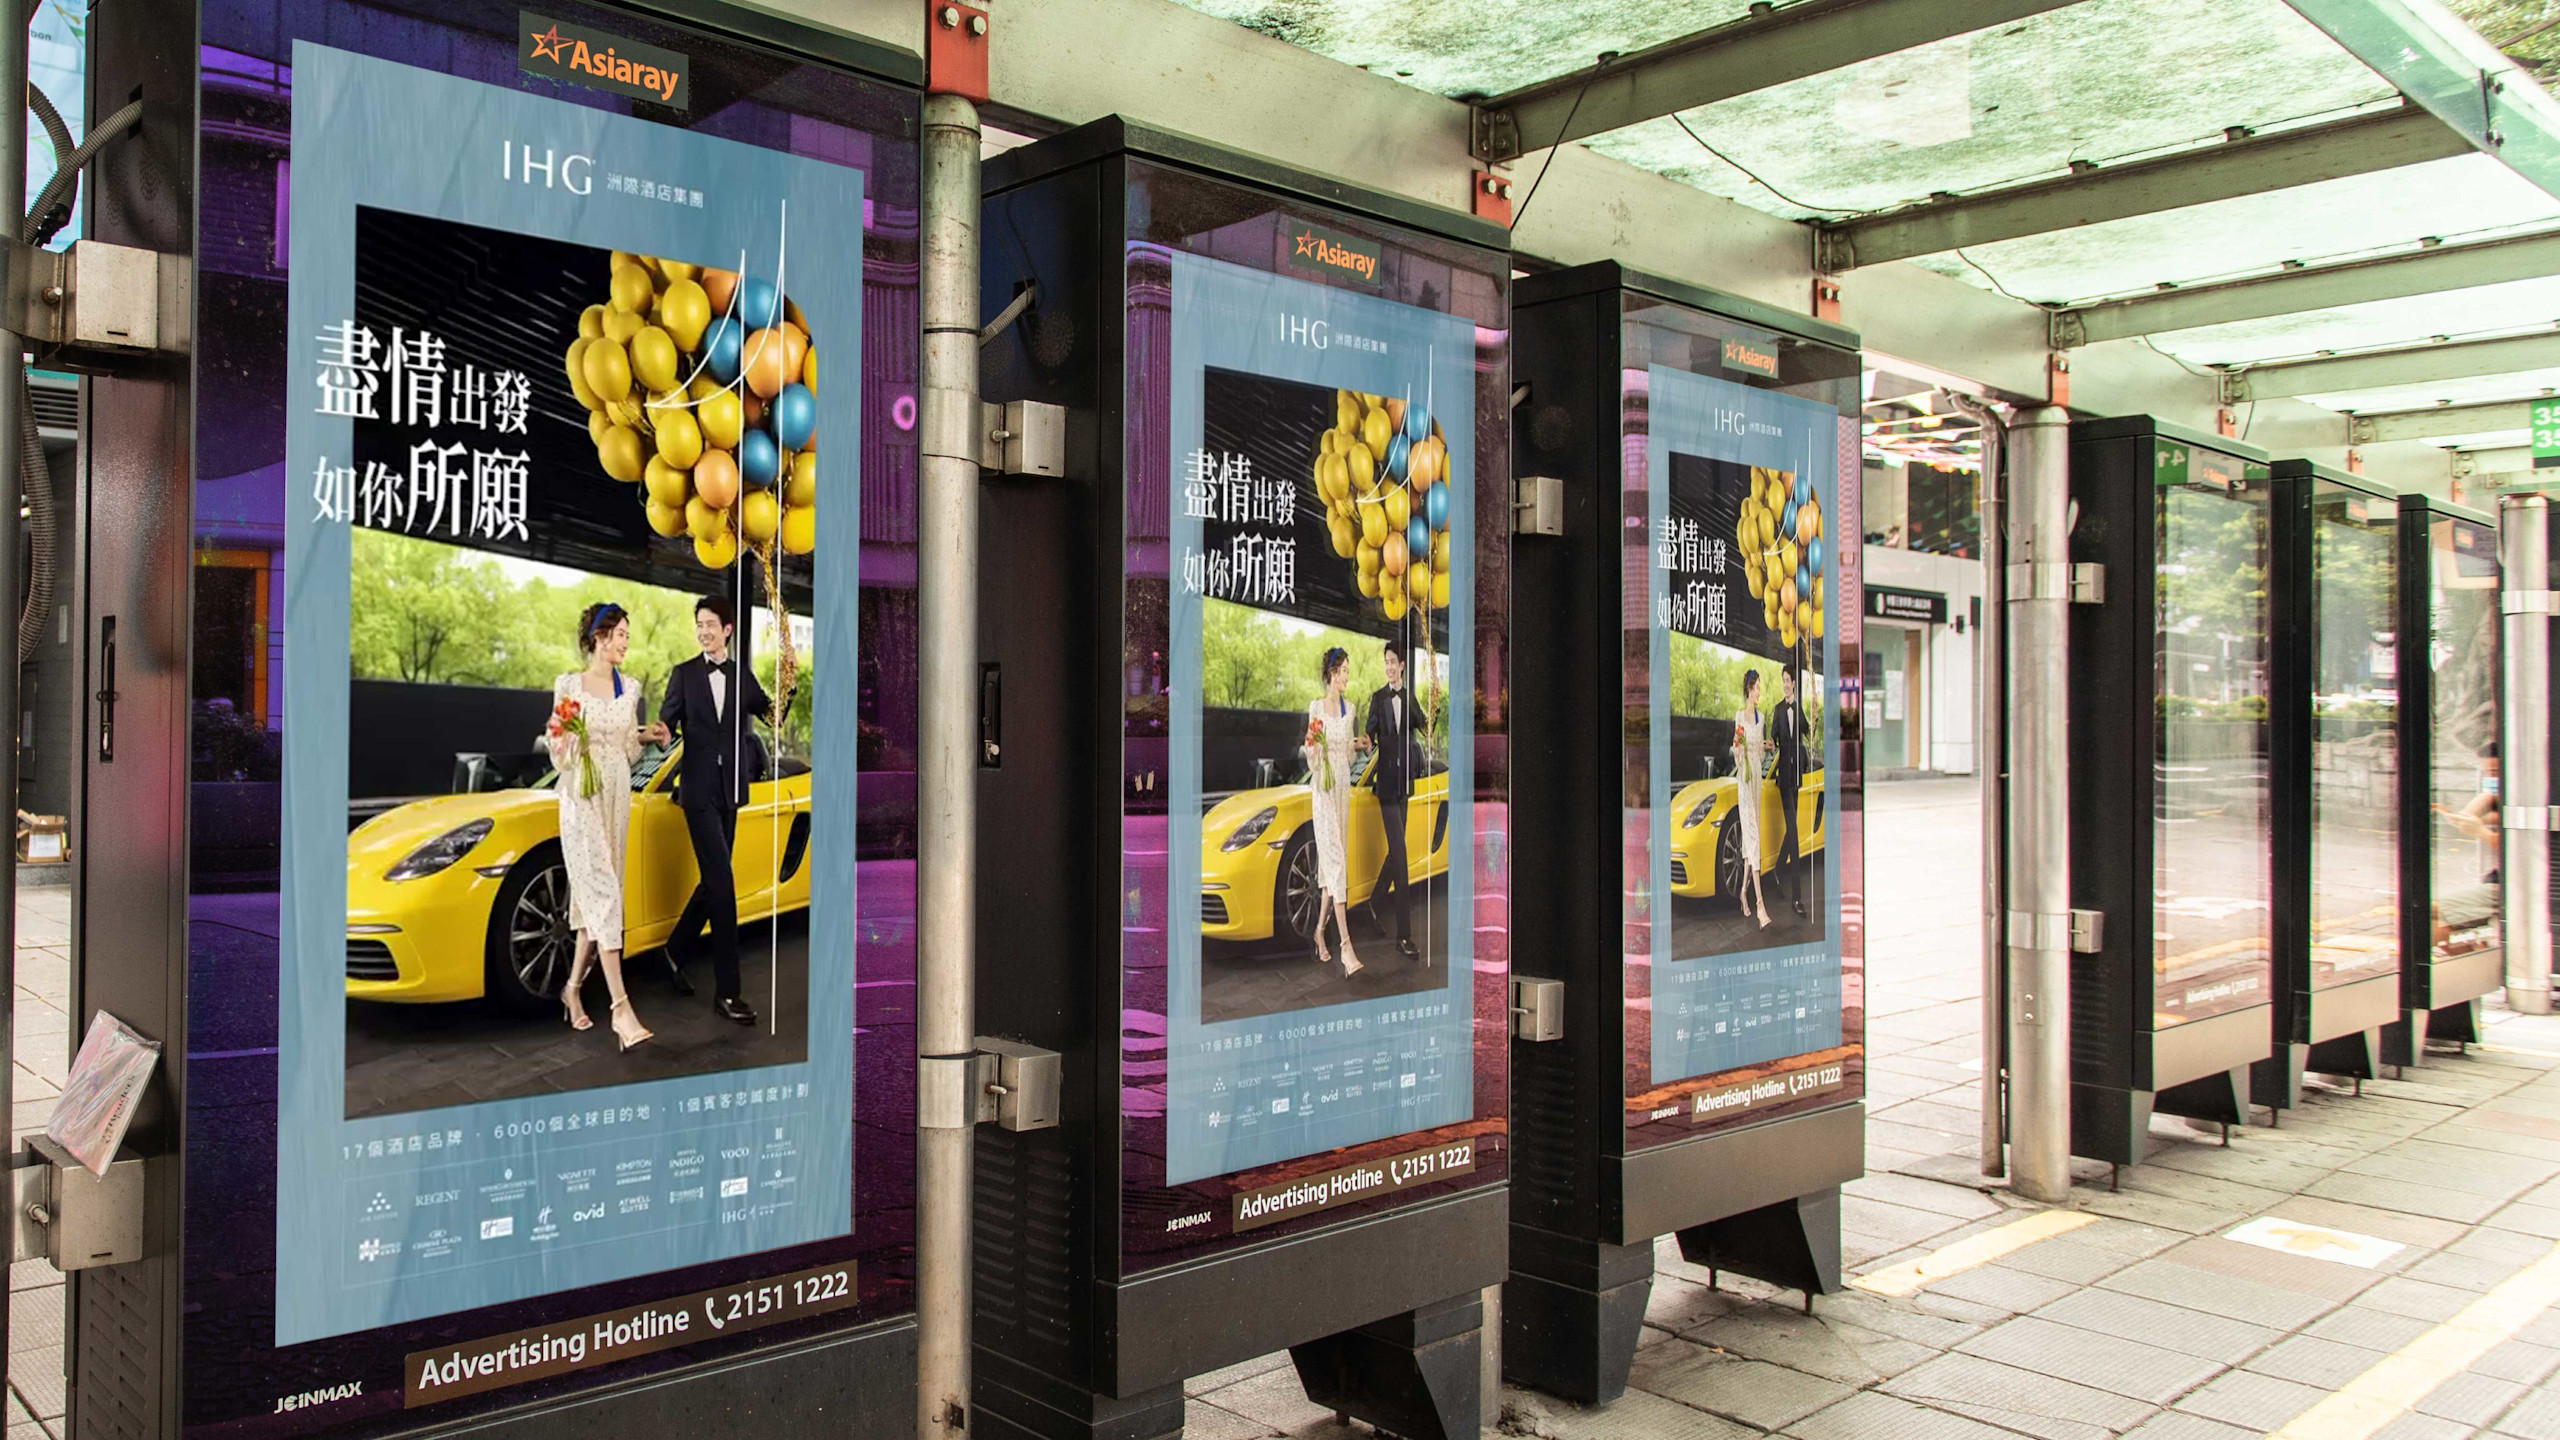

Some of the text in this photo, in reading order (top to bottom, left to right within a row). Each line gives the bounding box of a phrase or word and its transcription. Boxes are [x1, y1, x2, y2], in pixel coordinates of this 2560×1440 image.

[569, 40, 679, 100] Asiaray
[503, 140, 593, 195] IHG
[606, 172, 704, 208] 洲際酒店集團
[1316, 239, 1376, 279] Asiaray
[1280, 312, 1328, 349] IHG
[314, 319, 532, 435] 盡情出發
[1738, 345, 1776, 376] Asiaray
[1715, 407, 1745, 436] IHG
[311, 438, 531, 542] 如你所願
[1183, 447, 1297, 526] 盡情出發
[1181, 531, 1297, 604] 如你所願
[1657, 514, 1726, 575] 盡情出發
[1657, 579, 1727, 636] 如你所願
[1321, 1088, 1339, 1103] avid
[1695, 1066, 1841, 1114] Advertising Hotline 2151 1222
[342, 1129, 463, 1160] 17個酒店品牌
[494, 1104, 650, 1140] 6000個全球目的地
[616, 1159, 652, 1171] KIMPTON
[669, 1154, 704, 1168] INDIGO
[1239, 1145, 1471, 1219] Advertising Hotline 2151 1222
[415, 1189, 461, 1207] REGENT
[573, 1202, 605, 1222] avid
[722, 1208, 746, 1224] IHG
[418, 1271, 849, 1390] Advertising Hotline 2151 1222
